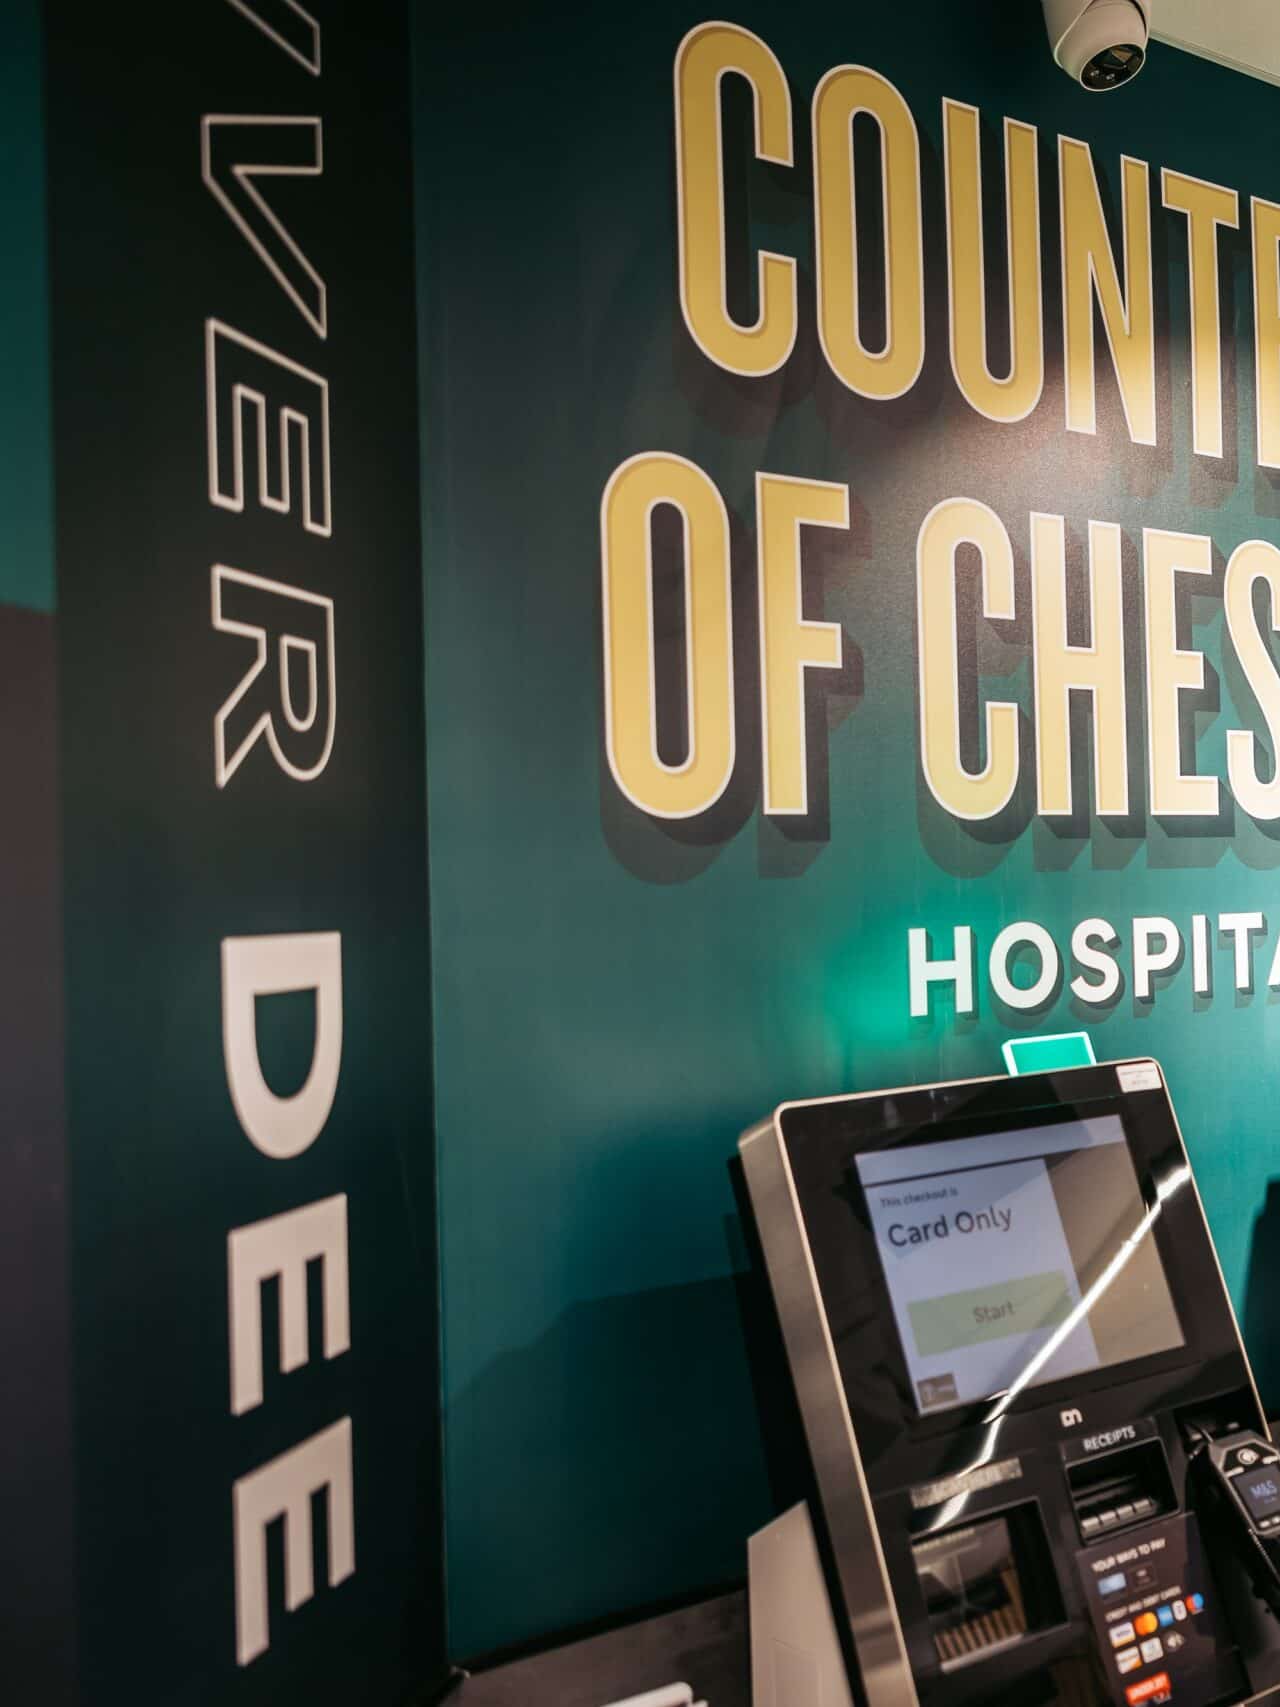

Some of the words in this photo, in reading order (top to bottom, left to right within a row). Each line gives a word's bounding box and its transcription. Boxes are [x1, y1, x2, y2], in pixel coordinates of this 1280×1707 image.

[600, 451, 850, 819] OF
[887, 1215, 949, 1247] Card
[955, 1204, 1013, 1233] Only
[221, 931, 356, 1667] DEE
[973, 1301, 1015, 1324] Start
[1083, 1425, 1137, 1451] RECEIPTS
